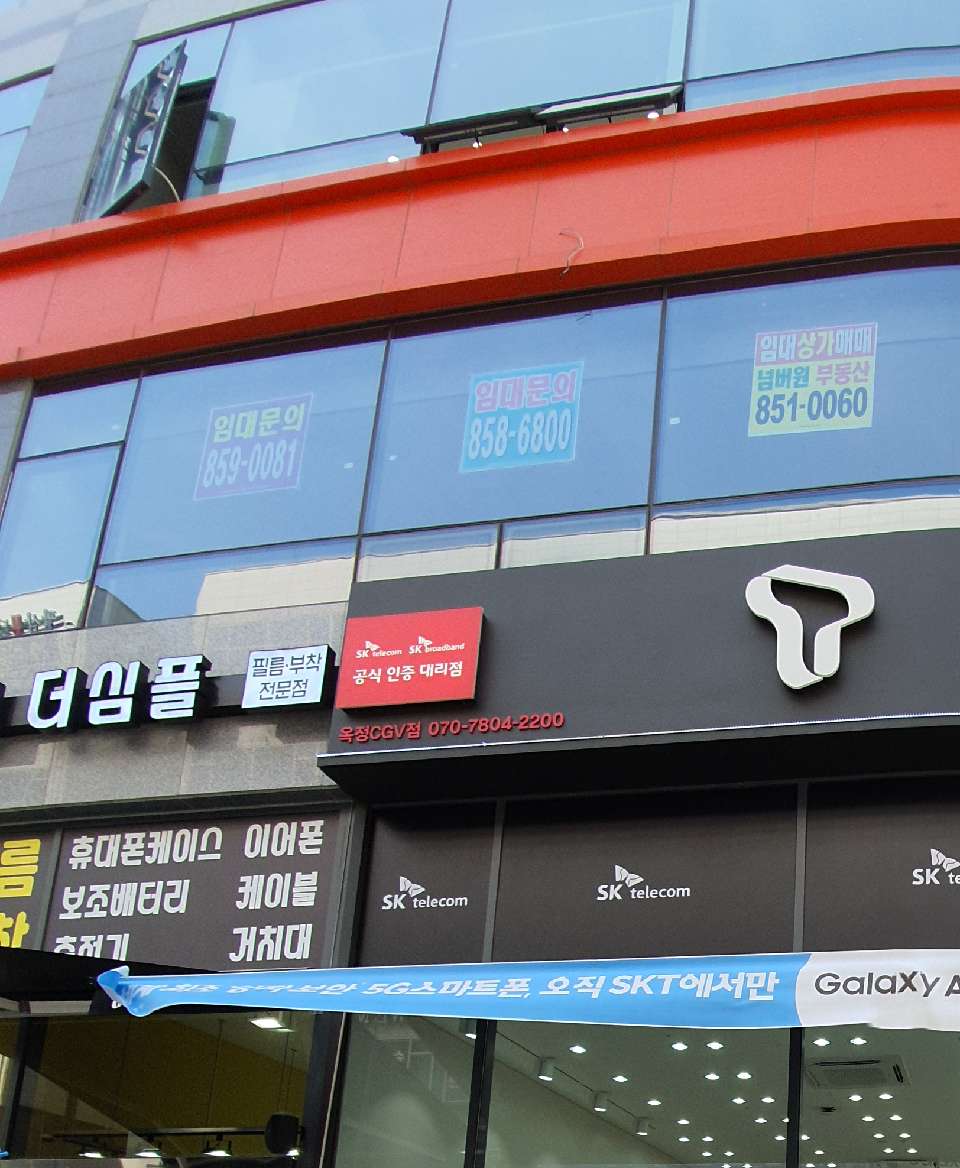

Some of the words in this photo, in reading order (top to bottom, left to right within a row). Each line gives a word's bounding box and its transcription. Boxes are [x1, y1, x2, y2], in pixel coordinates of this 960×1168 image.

[816, 361, 869, 386] 부동산
[474, 369, 577, 411] 임대문의
[213, 403, 304, 440] 임대문의
[755, 387, 868, 425] 851-0060
[468, 409, 572, 459] 858-6800
[202, 443, 298, 489] 859-0081
[372, 648, 402, 658] telecom
[425, 641, 465, 654] broadband
[352, 668, 382, 685] 공식
[386, 664, 415, 683] 인증
[419, 661, 463, 679] 대리점
[27, 655, 204, 729] 더심플
[258, 678, 309, 700] 전문점
[427, 712, 566, 738] 070-7804-2200
[68, 827, 224, 870] 휴대폰케이스
[244, 819, 324, 858] 이어폰
[597, 884, 624, 901] SK
[630, 886, 691, 900] telecom
[912, 868, 941, 886] SK
[59, 880, 191, 920] 보조배터리
[235, 871, 318, 910] 케이블
[381, 894, 406, 911] SK
[413, 895, 468, 909] telecom
[228, 923, 313, 963] 거치대
[538, 975, 606, 999] 오직
[608, 970, 780, 1001] SKT에서만
